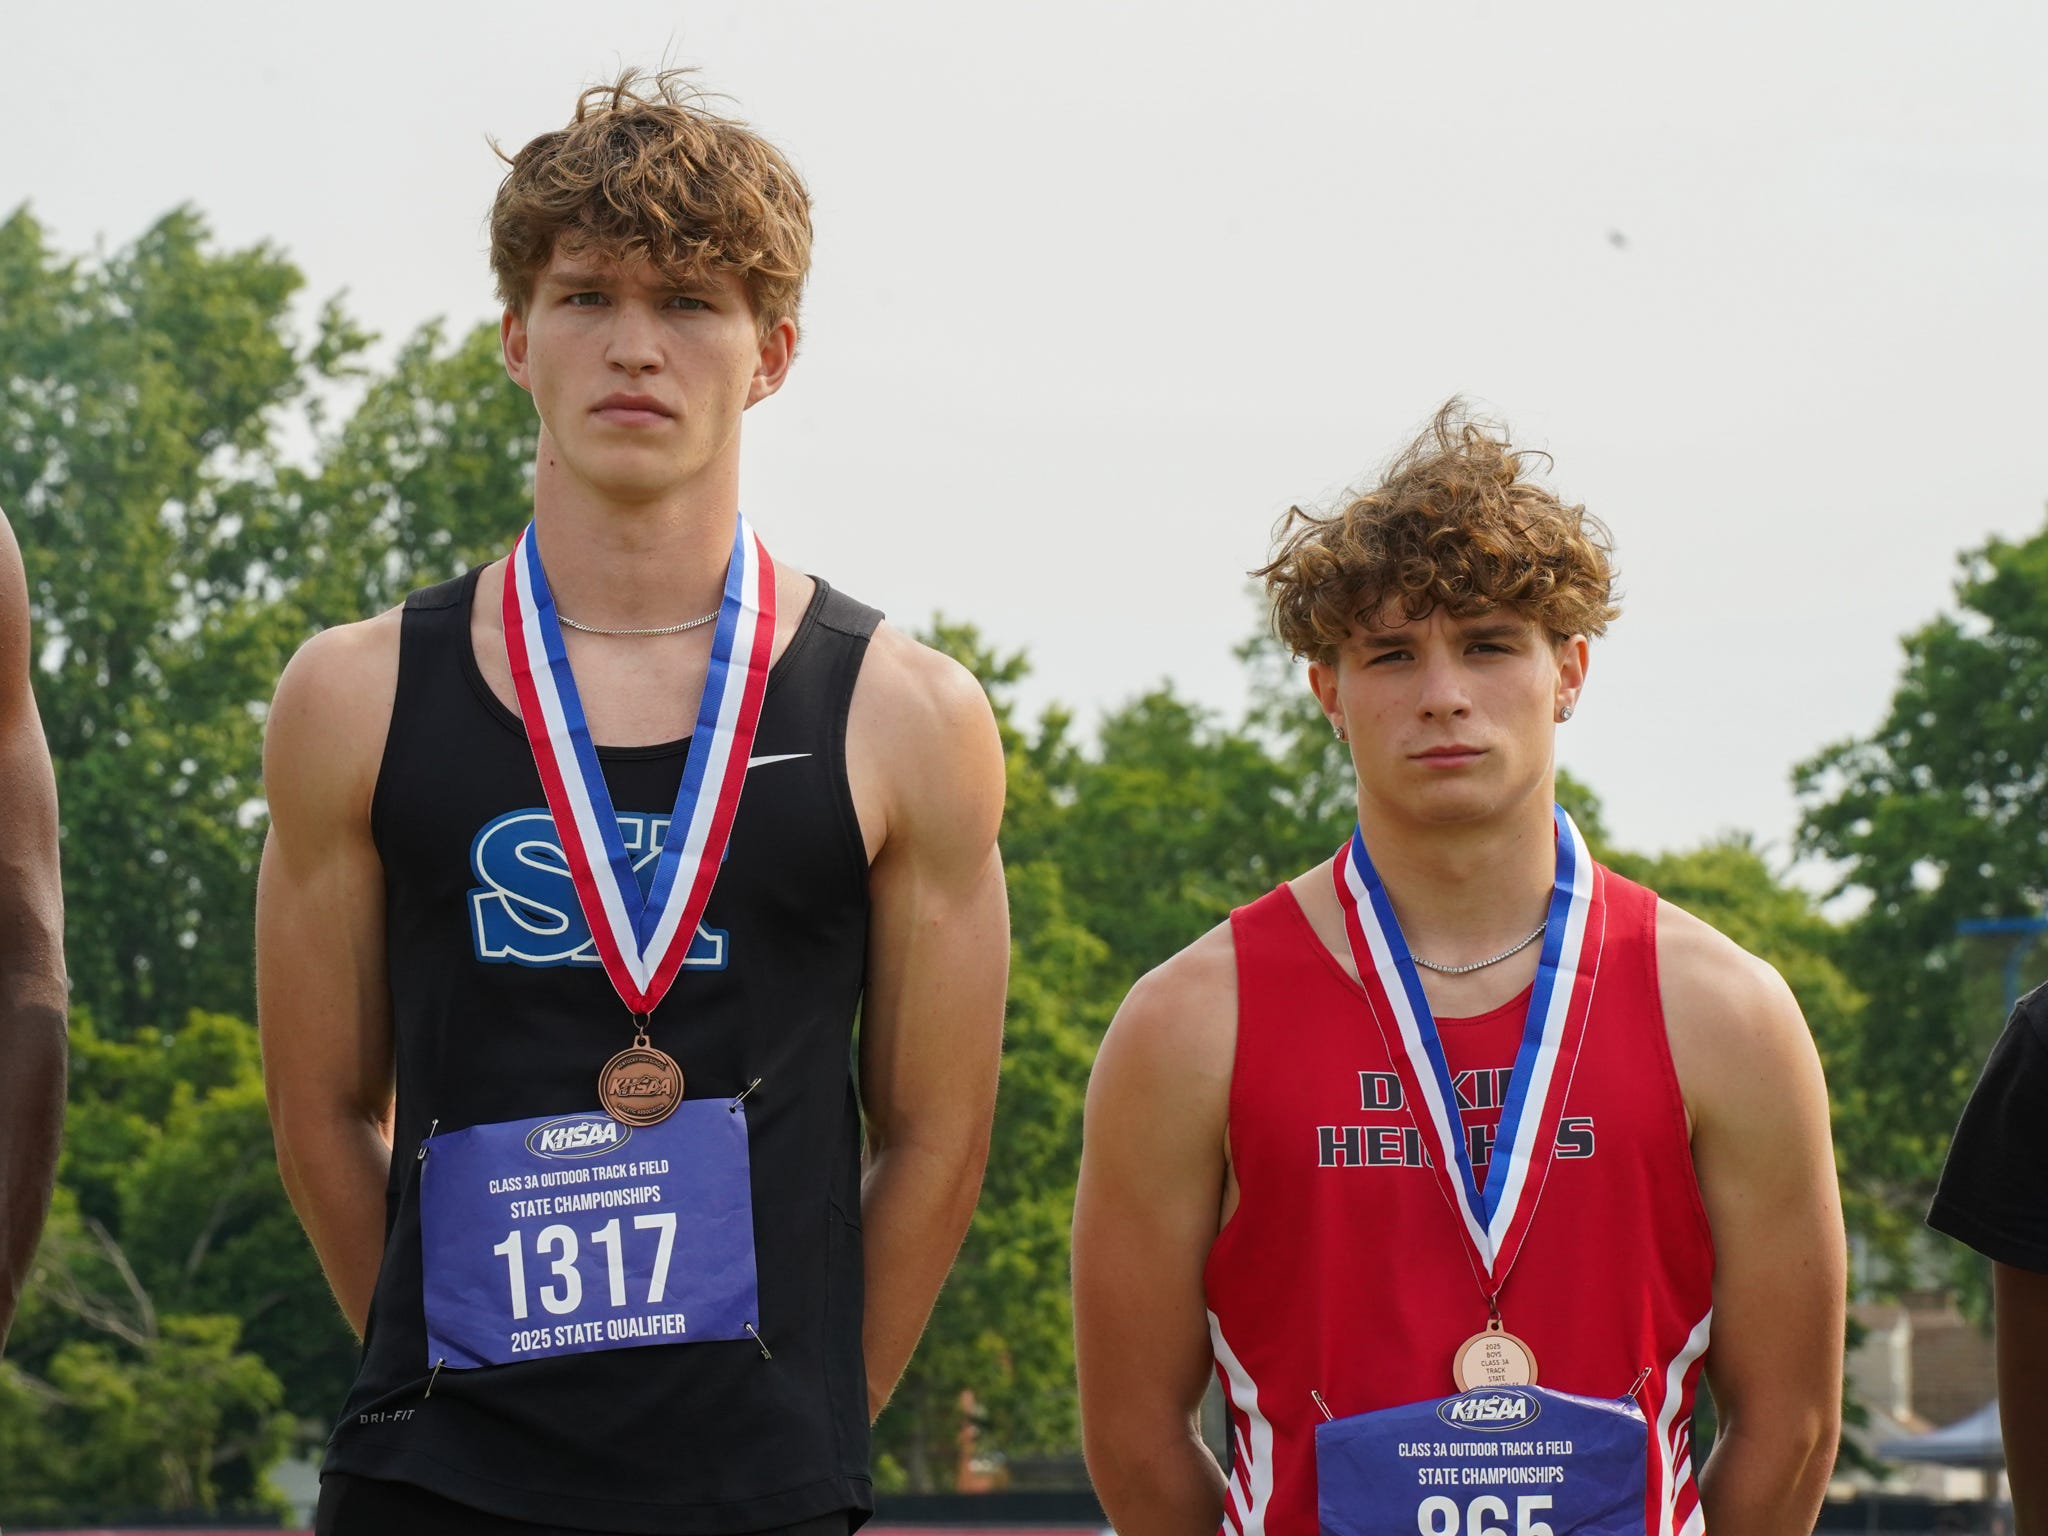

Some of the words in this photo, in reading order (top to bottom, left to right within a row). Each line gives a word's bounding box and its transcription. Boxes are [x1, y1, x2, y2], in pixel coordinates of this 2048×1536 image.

[540, 1122, 618, 1152] KHSAA
[1316, 1117, 1594, 1168] HEIHS
[489, 1177, 522, 1194] CLASS
[525, 1175, 539, 1190] 3A
[541, 1170, 590, 1187] OUTDOOR
[592, 1165, 627, 1181] TRACK
[630, 1163, 637, 1177] &
[639, 1159, 669, 1175] FIELD
[510, 1198, 552, 1219] STATE
[554, 1185, 661, 1214] CHAMPIONSHIPS
[493, 1212, 678, 1320] 1317
[511, 1328, 551, 1353] 2025
[555, 1321, 604, 1345] STATE
[607, 1314, 686, 1340] QUALIFIER
[1481, 1359, 1500, 1367] CLASS
[360, 1409, 415, 1424] DRI-FIT
[1451, 1398, 1527, 1422] KHSAA
[1398, 1442, 1430, 1457] CLASS
[1433, 1442, 1448, 1457] 3A
[1450, 1442, 1498, 1457] OUTDOOR
[1500, 1442, 1534, 1456] TRACK
[1536, 1442, 1544, 1455] &
[1546, 1440, 1573, 1455] FIELD
[1418, 1467, 1459, 1485] STATE
[1462, 1466, 1564, 1485] CHAMPIONSHIPS
